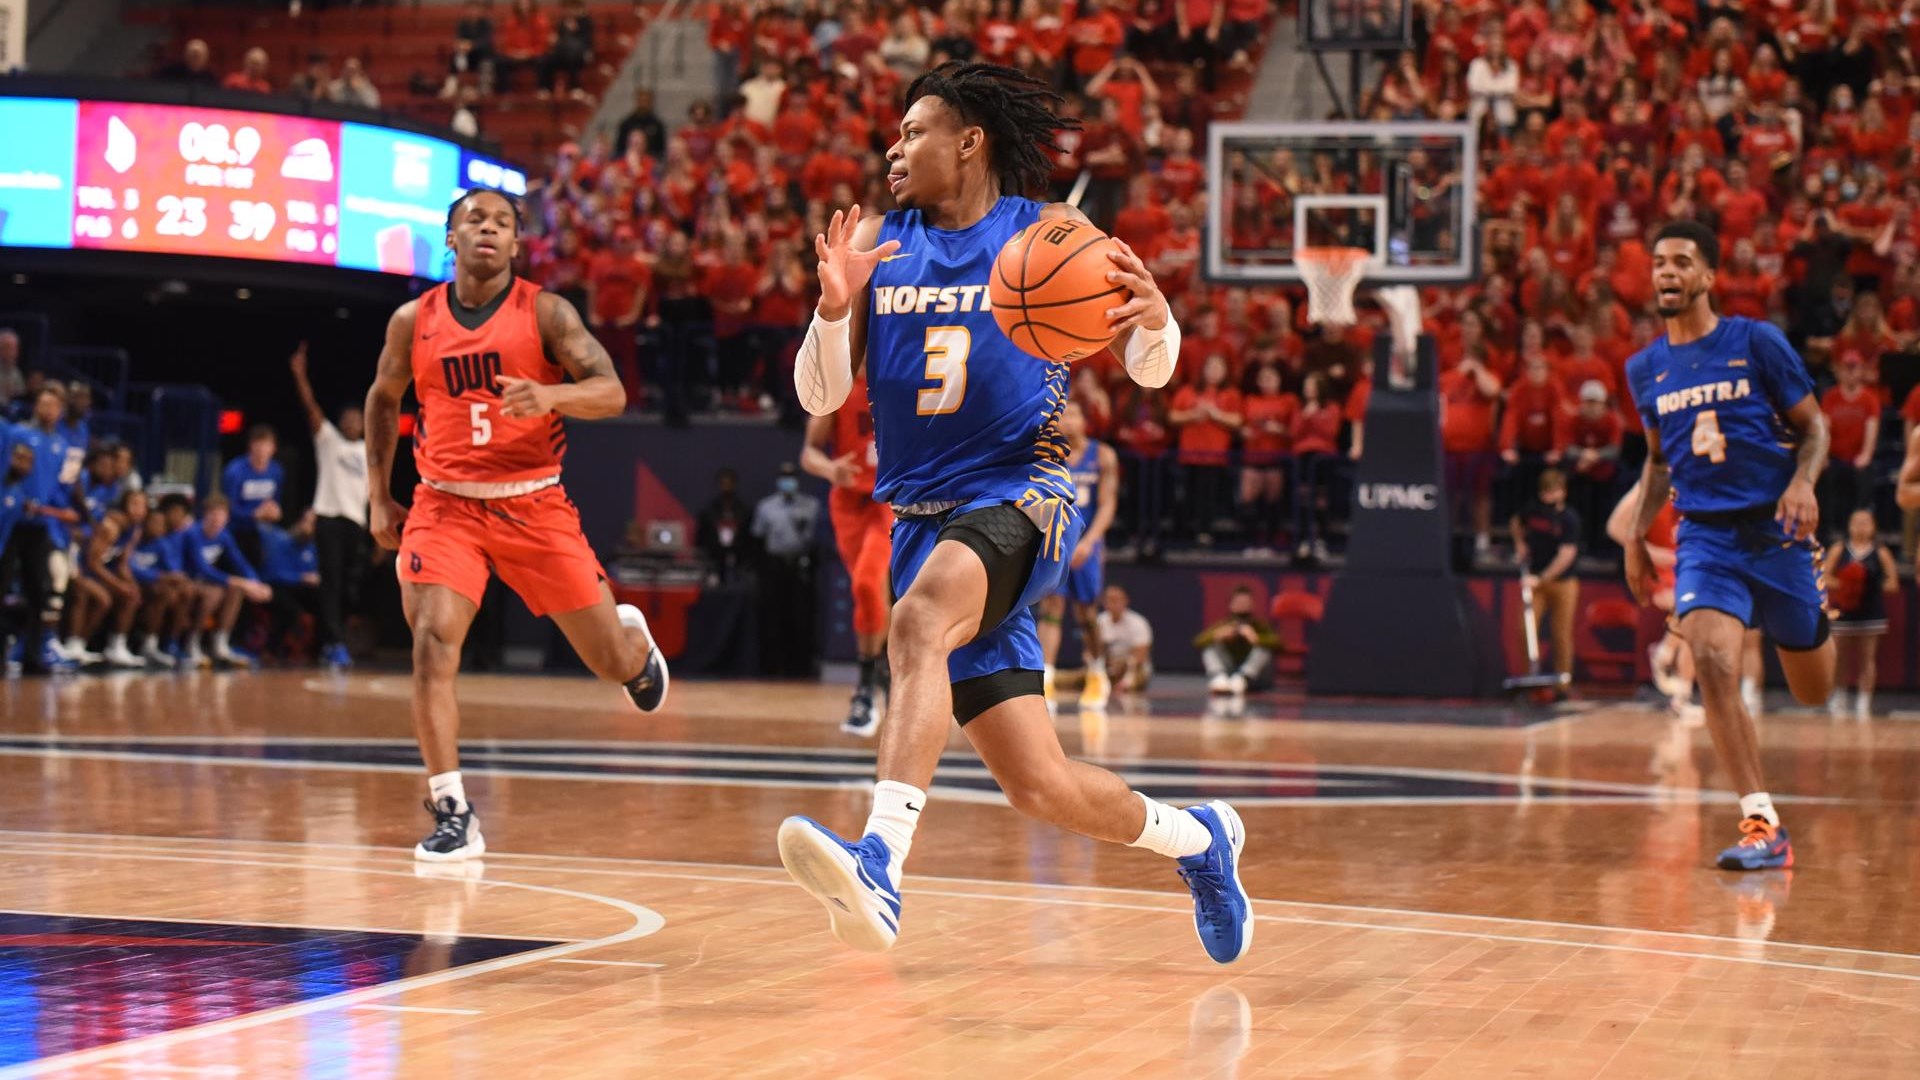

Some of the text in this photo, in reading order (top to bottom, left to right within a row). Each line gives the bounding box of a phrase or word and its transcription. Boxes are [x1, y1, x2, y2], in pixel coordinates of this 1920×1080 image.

[179, 122, 261, 165] 08.9
[228, 200, 276, 241] 39
[916, 325, 971, 416] 3
[1656, 378, 1750, 416] HOFSTRA
[470, 403, 492, 446] 5
[1691, 409, 1727, 464] 4
[1358, 483, 1439, 510] UPMC
